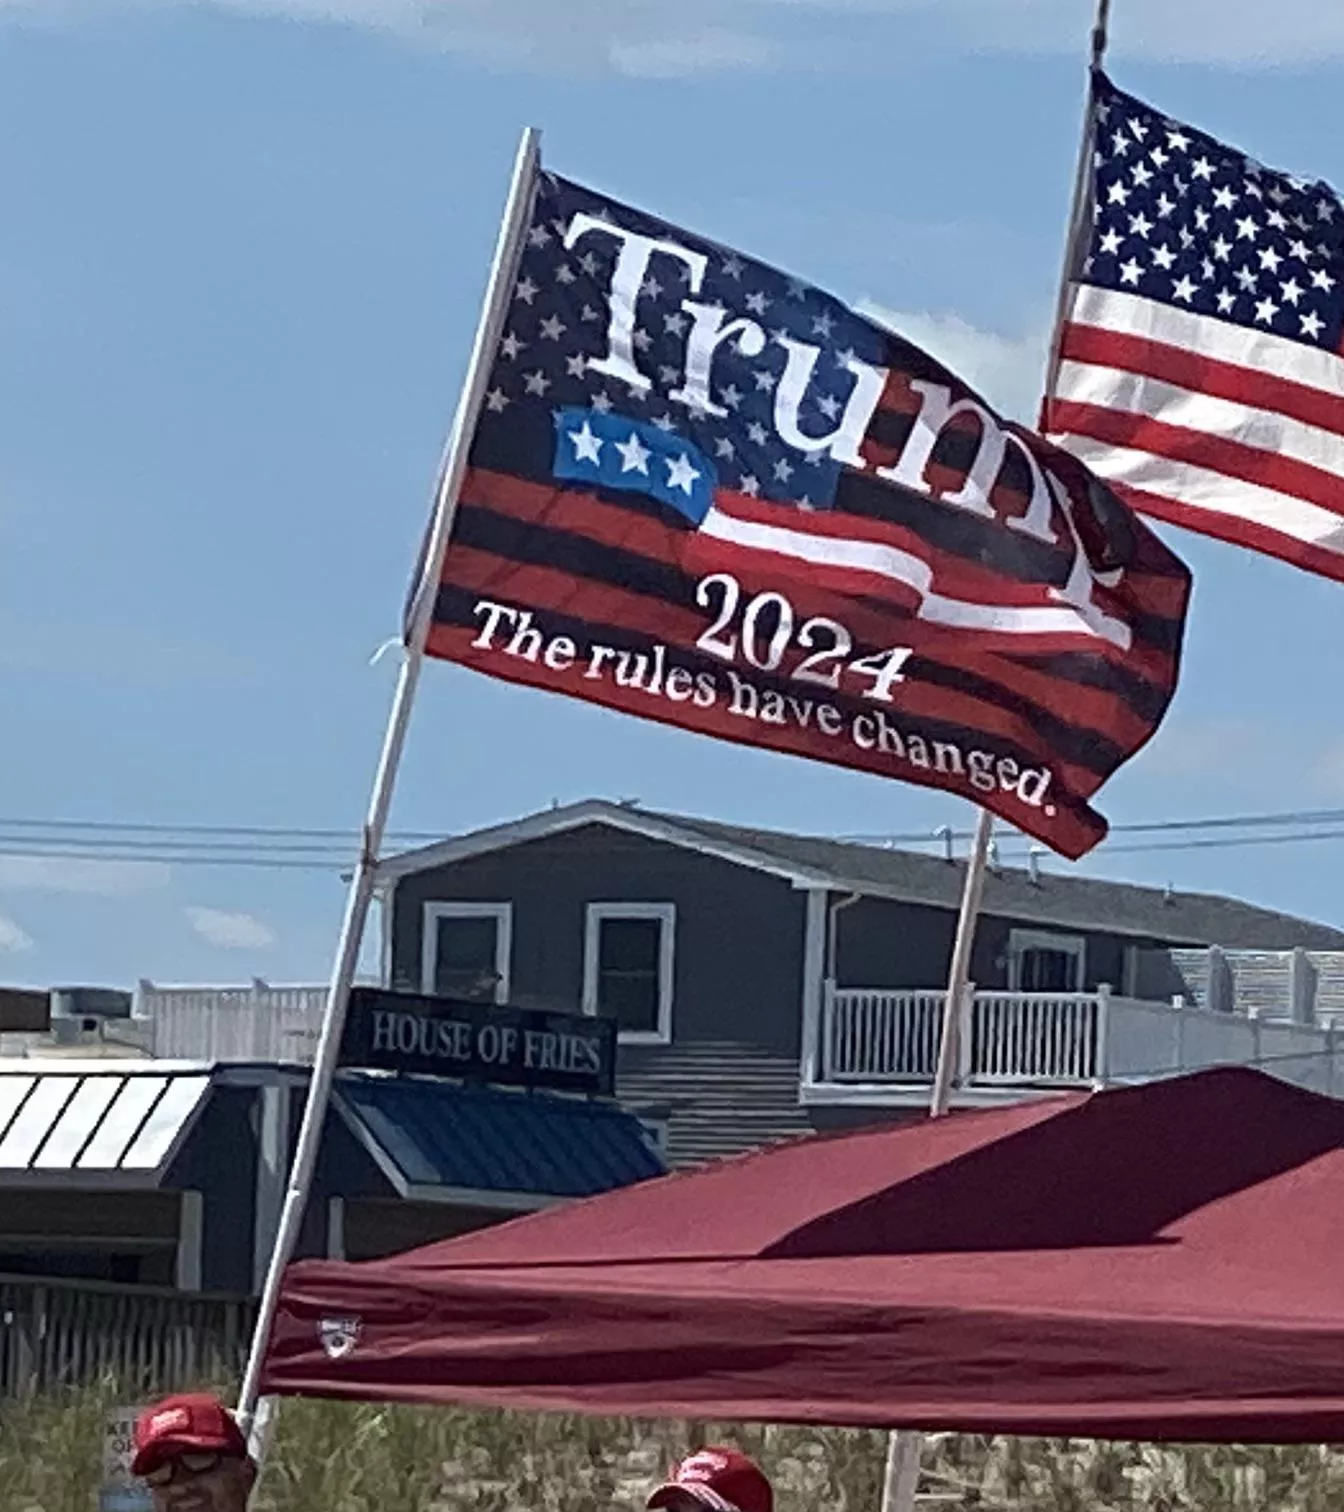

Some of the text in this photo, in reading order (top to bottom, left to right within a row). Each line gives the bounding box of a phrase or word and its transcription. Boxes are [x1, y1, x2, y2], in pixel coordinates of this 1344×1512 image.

[695, 572, 914, 704] 2024
[470, 601, 1058, 817] The rules have changed.
[371, 1009, 602, 1074] HOUSE OF FRIES
